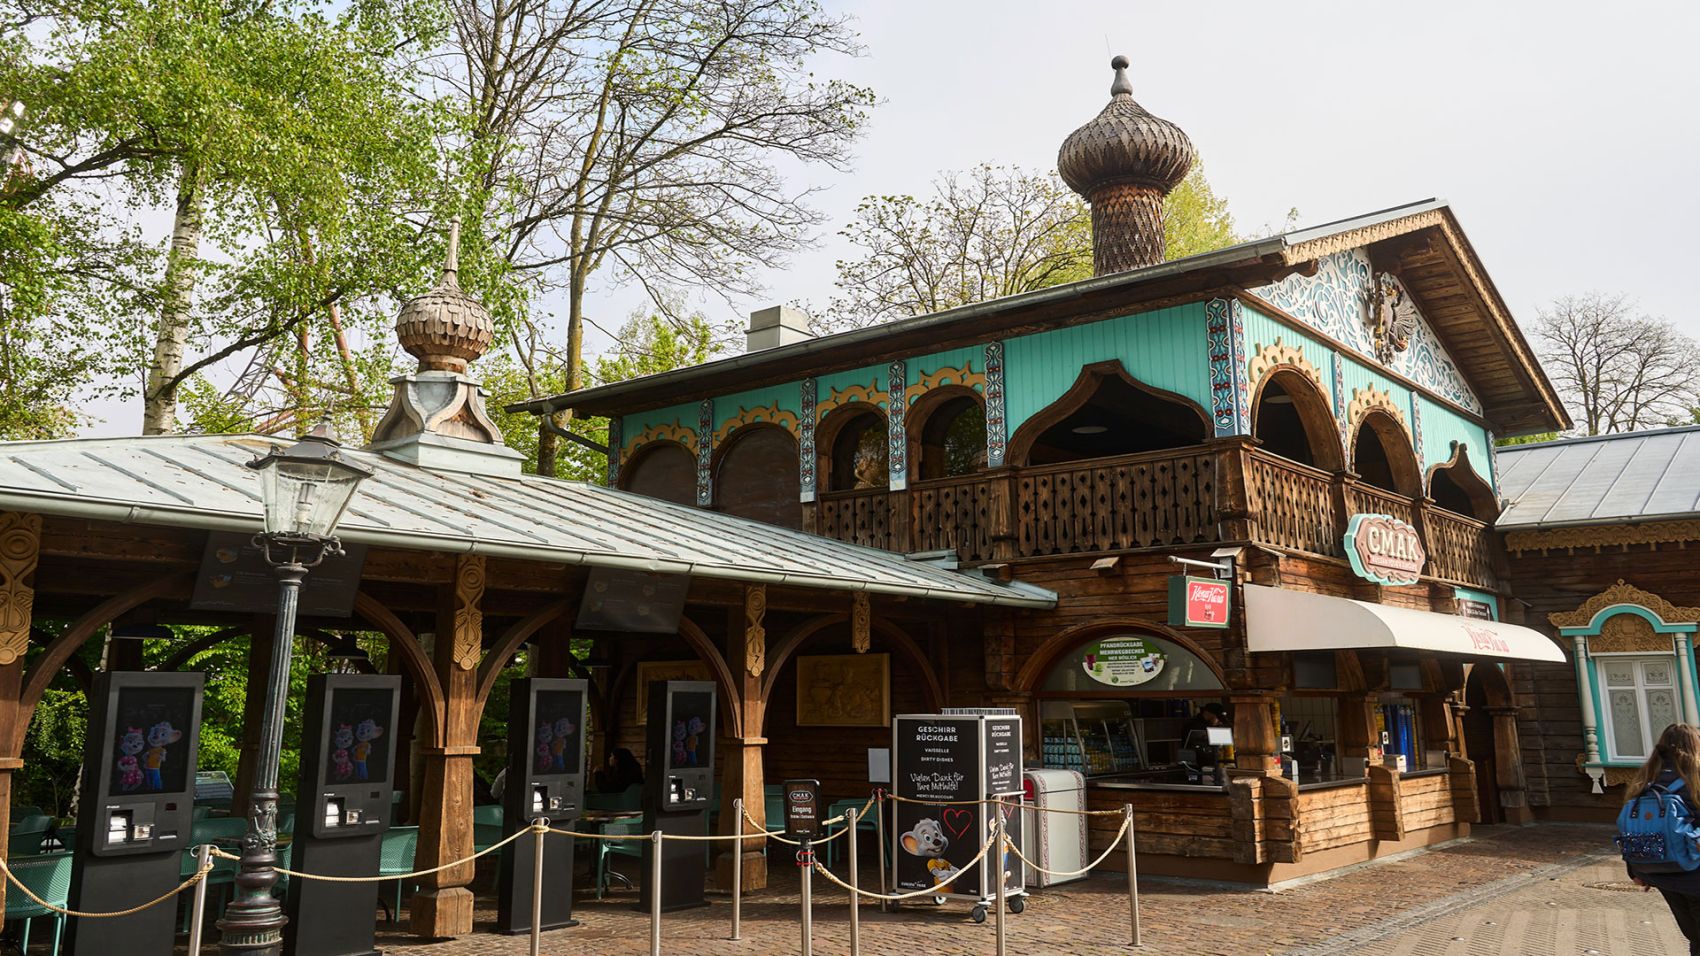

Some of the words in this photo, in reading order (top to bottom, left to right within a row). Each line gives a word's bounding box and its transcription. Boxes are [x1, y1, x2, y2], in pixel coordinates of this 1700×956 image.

[916, 733, 959, 742] RÜCKGABE
[909, 772, 931, 782] Vielen
[931, 772, 953, 782] Dank
[916, 782, 930, 791] Ihre
[792, 805, 812, 814] Eingang
